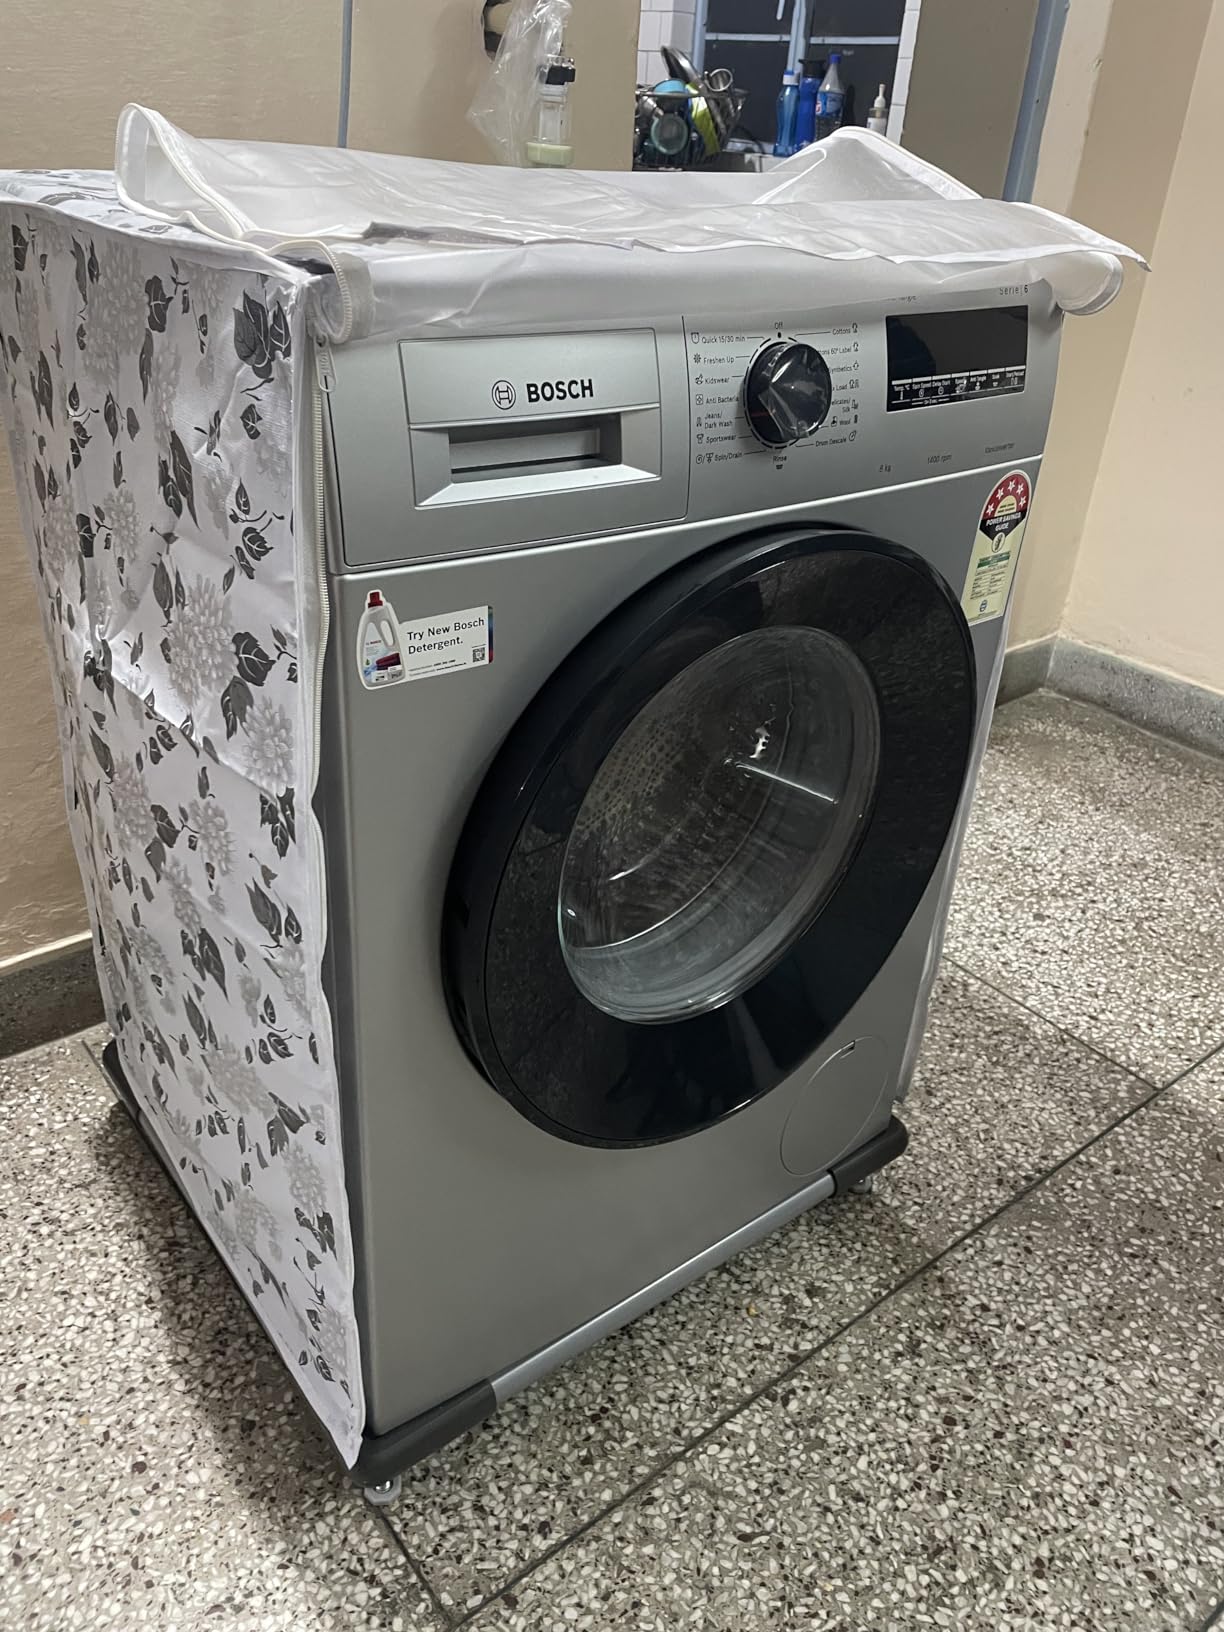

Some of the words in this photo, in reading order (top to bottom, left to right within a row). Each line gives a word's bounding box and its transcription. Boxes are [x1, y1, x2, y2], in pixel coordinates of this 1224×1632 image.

[832, 328, 851, 336] Cottons
[701, 336, 717, 344] Quick
[718, 335, 735, 344] 15/30
[726, 356, 735, 364] Up
[704, 377, 730, 385] Kidswear
[526, 378, 594, 403] BOSCH
[705, 435, 737, 445] Sportswear
[986, 517, 1003, 527] POWER
[1002, 512, 1021, 522] SAVINGS
[995, 522, 1009, 532] GUIDE
[407, 630, 424, 641] Try
[427, 625, 450, 637] New
[453, 617, 485, 632] Bosch
[408, 636, 464, 655] Detergent.
